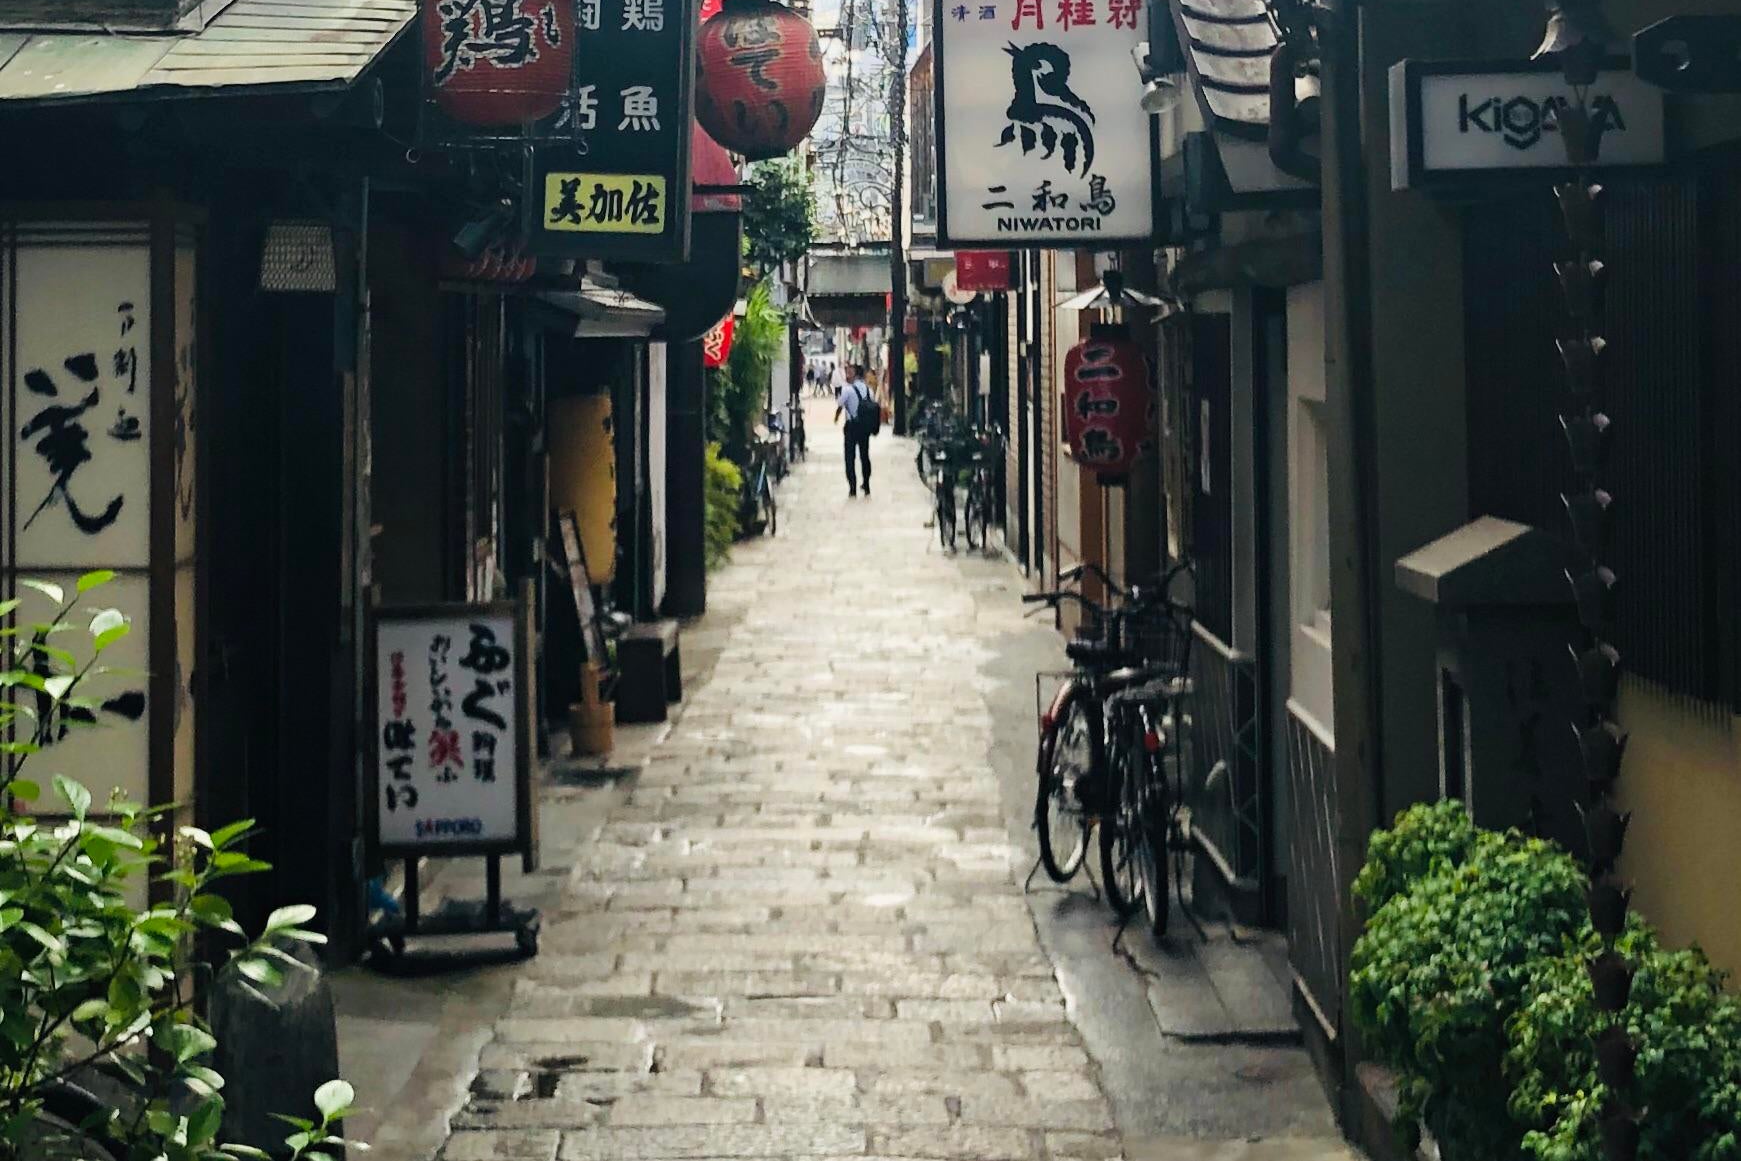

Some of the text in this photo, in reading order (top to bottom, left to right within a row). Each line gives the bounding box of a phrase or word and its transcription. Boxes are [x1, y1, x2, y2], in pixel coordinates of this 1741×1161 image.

[951, 4, 997, 22] 清酒
[549, 177, 661, 227] 美加佐
[996, 216, 1102, 233] NIWATORI
